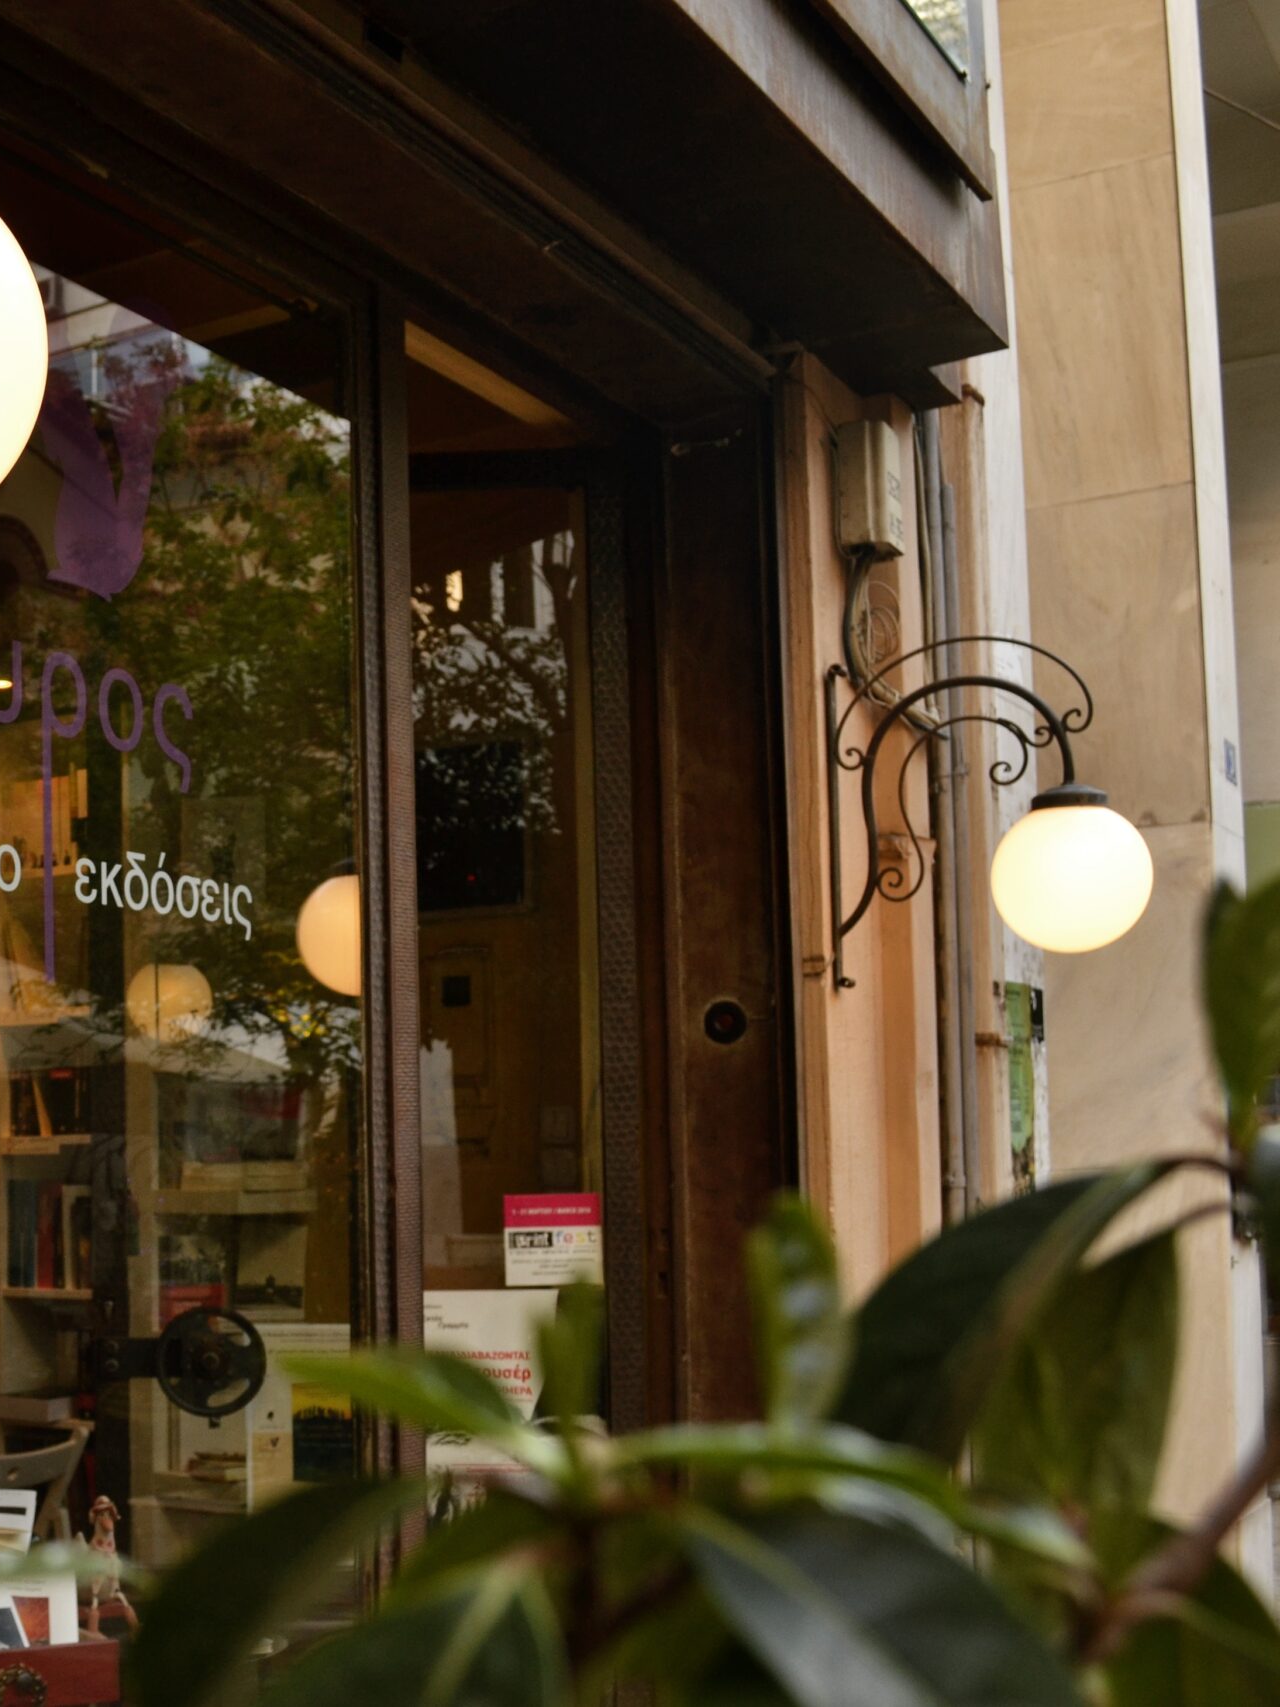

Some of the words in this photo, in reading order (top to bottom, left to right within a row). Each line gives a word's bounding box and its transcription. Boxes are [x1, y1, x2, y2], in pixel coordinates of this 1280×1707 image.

[74, 852, 252, 940] εκδόσεις
[555, 1230, 597, 1245] fest
[482, 1363, 531, 1383] ουσέρ
